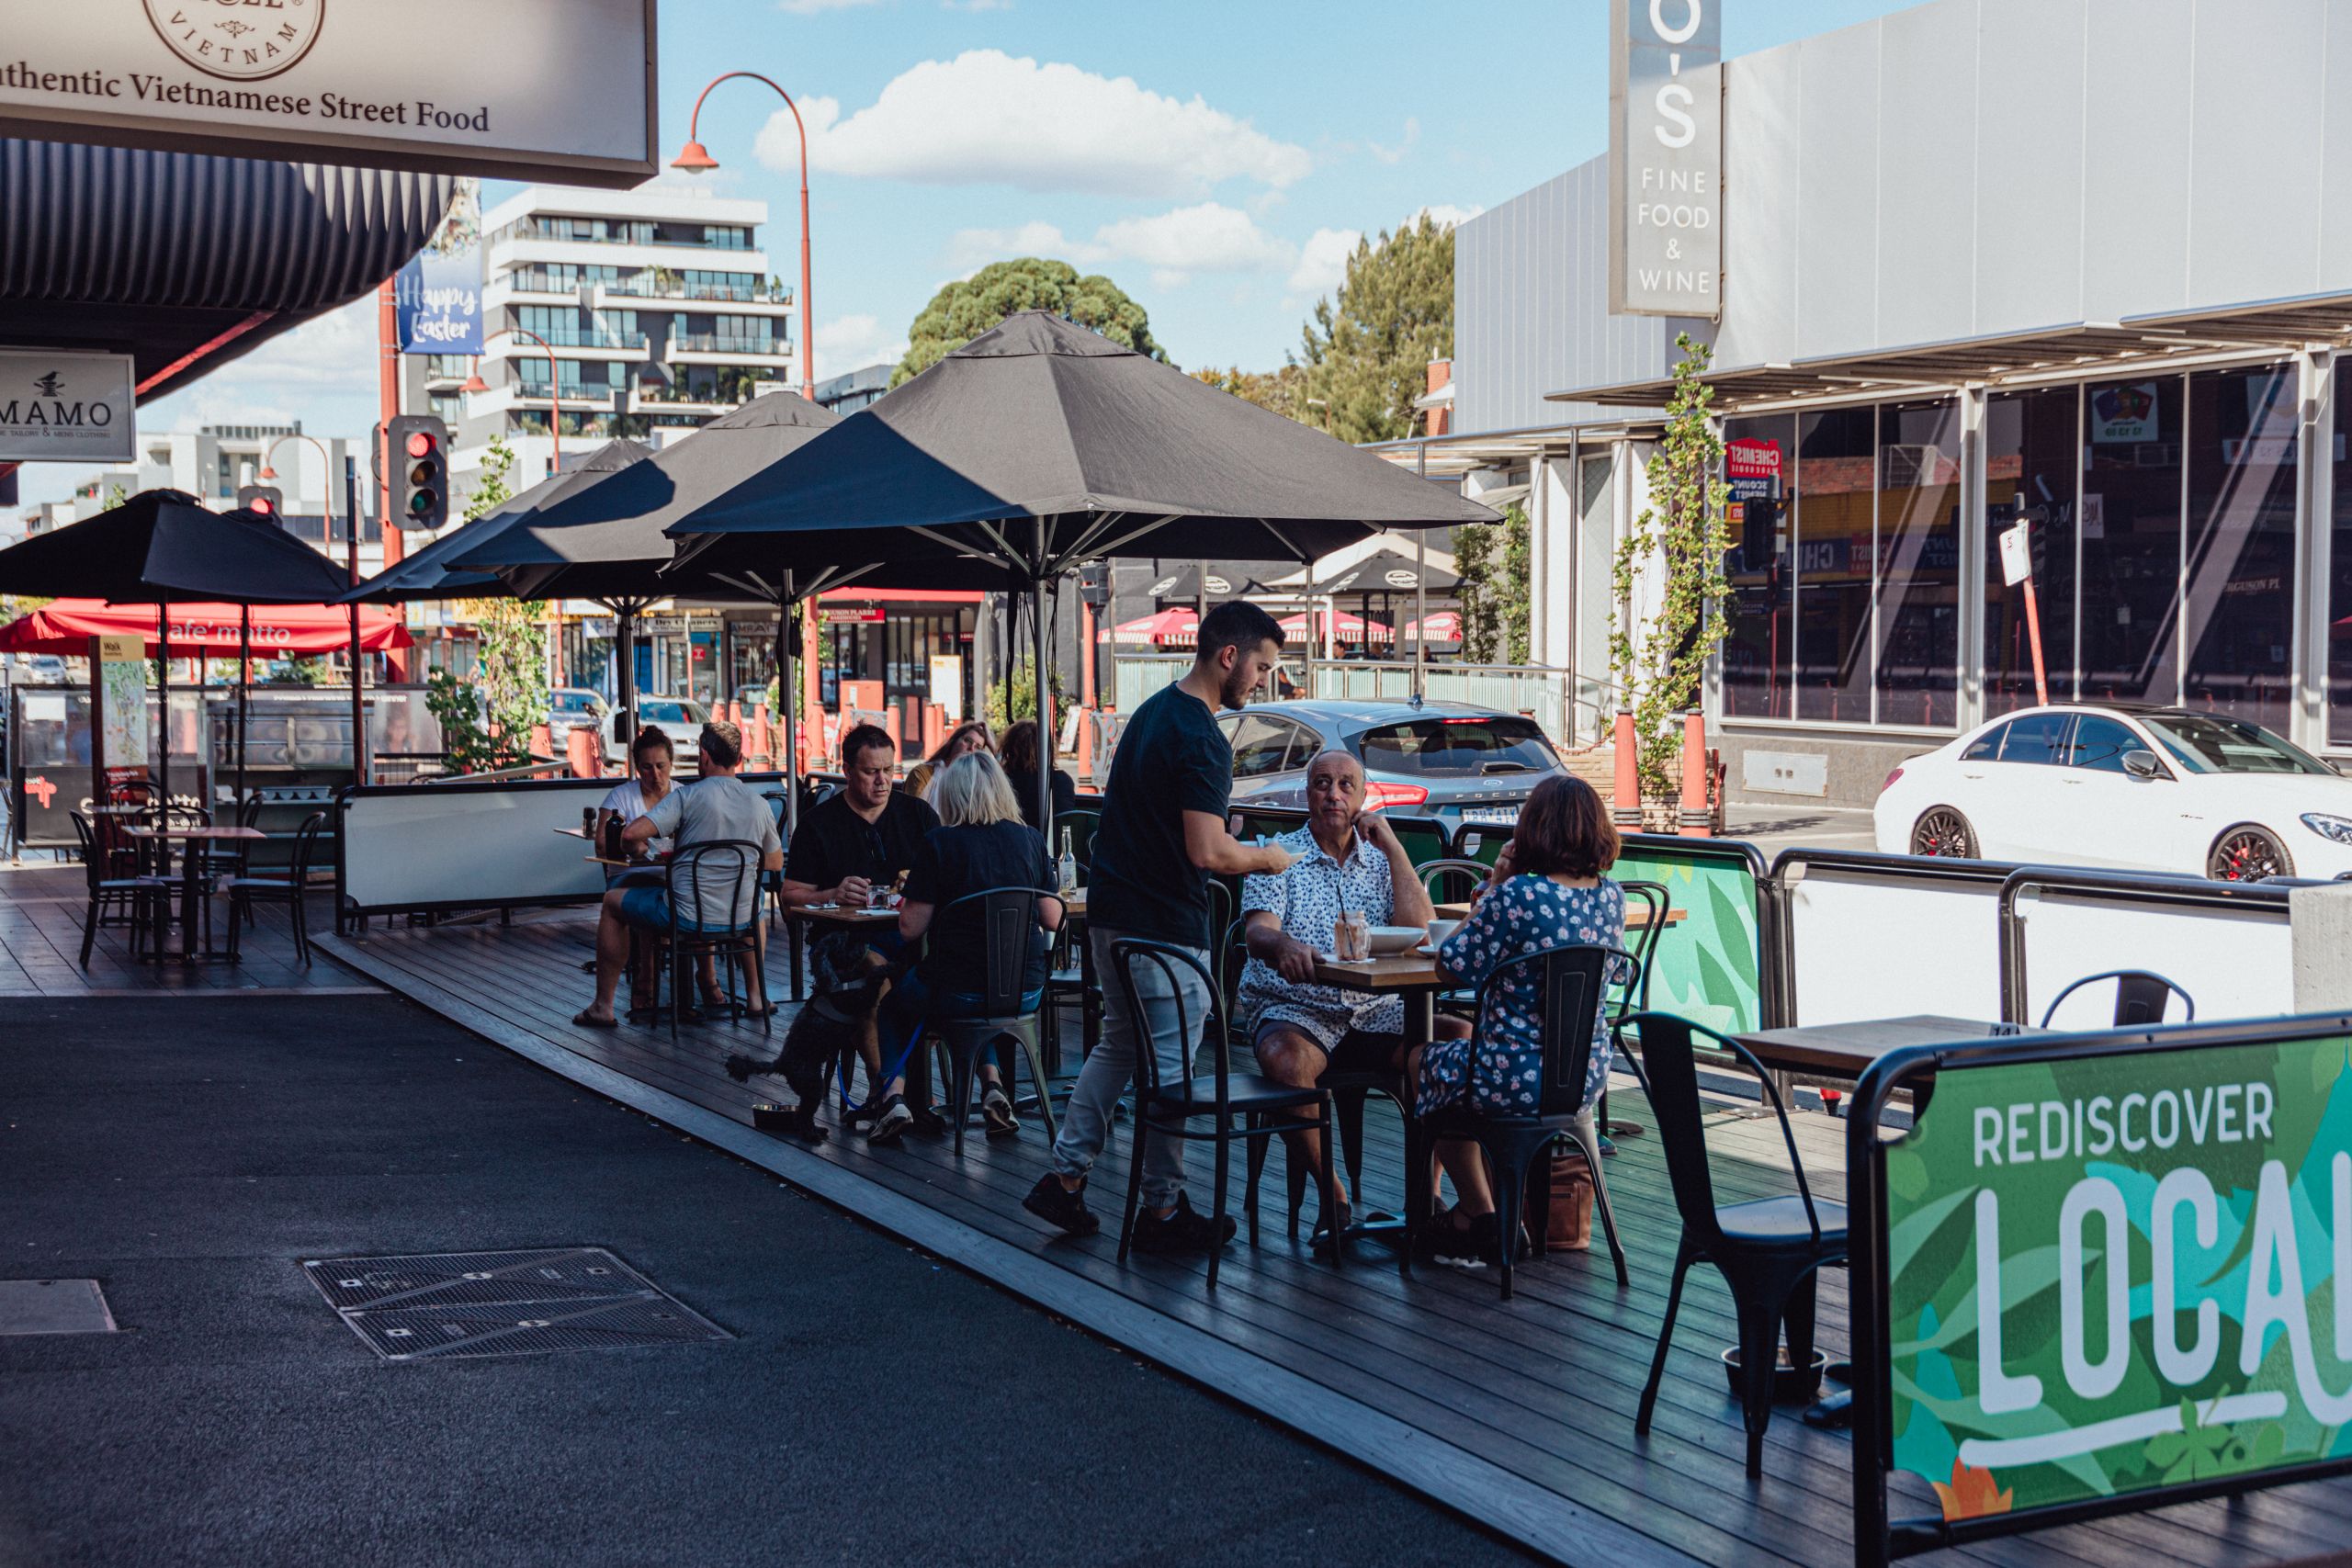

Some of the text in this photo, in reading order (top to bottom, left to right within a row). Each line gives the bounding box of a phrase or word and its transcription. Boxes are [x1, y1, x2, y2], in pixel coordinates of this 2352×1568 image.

[171, 10, 298, 64] VIETNAM
[129, 73, 311, 116] Vietnamese
[321, 92, 408, 125] Street
[415, 101, 491, 132] Food
[1641, 166, 1706, 194] FINE
[1637, 202, 1711, 230] FOOD
[1666, 237, 1681, 260] &
[400, 275, 478, 316] Happy
[1638, 267, 1711, 294] WINE
[411, 310, 471, 343] Easter
[1973, 1081, 2275, 1168] REDISCOVER
